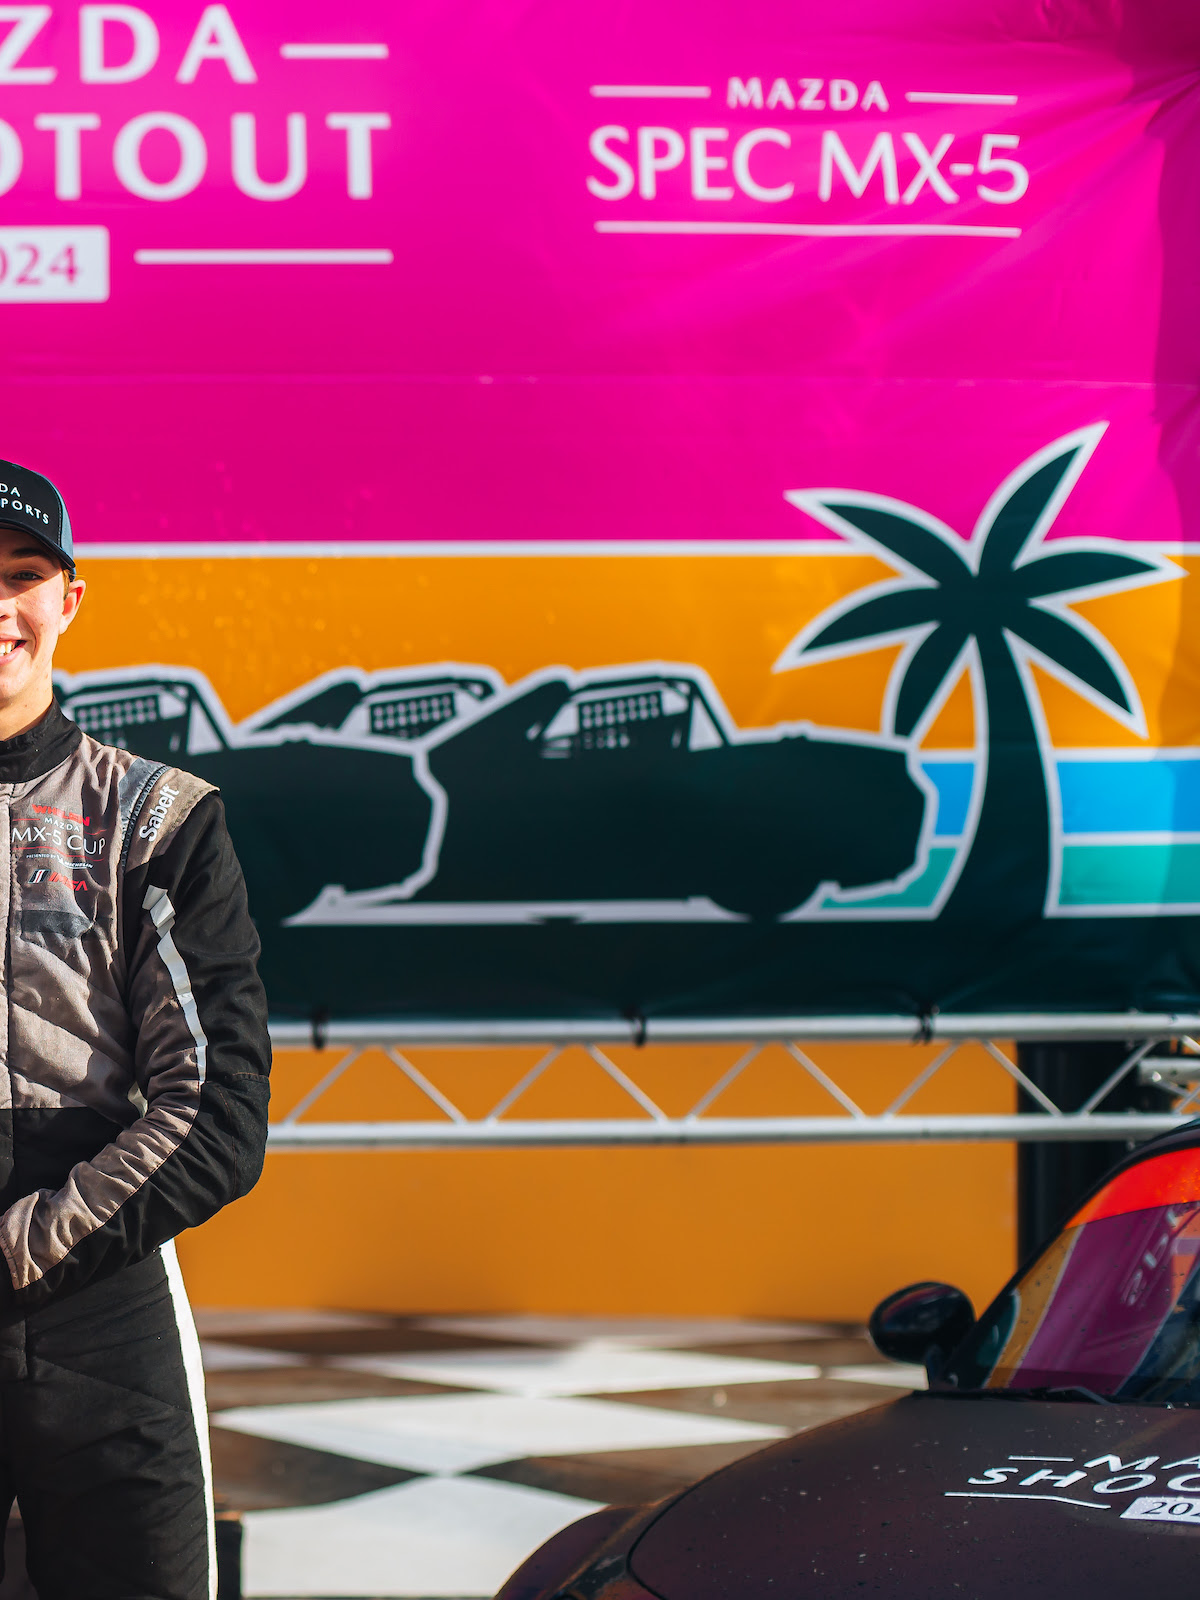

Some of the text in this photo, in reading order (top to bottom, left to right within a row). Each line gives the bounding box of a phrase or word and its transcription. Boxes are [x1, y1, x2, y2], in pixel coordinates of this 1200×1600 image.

[727, 77, 889, 111] MAZDA
[586, 125, 1029, 204] SPEC MX-5
[32, 804, 91, 826] WHELEN
[44, 817, 81, 832] MAZDA
[139, 784, 179, 842] Sabelt
[11, 827, 106, 855] MX-5 CUP
